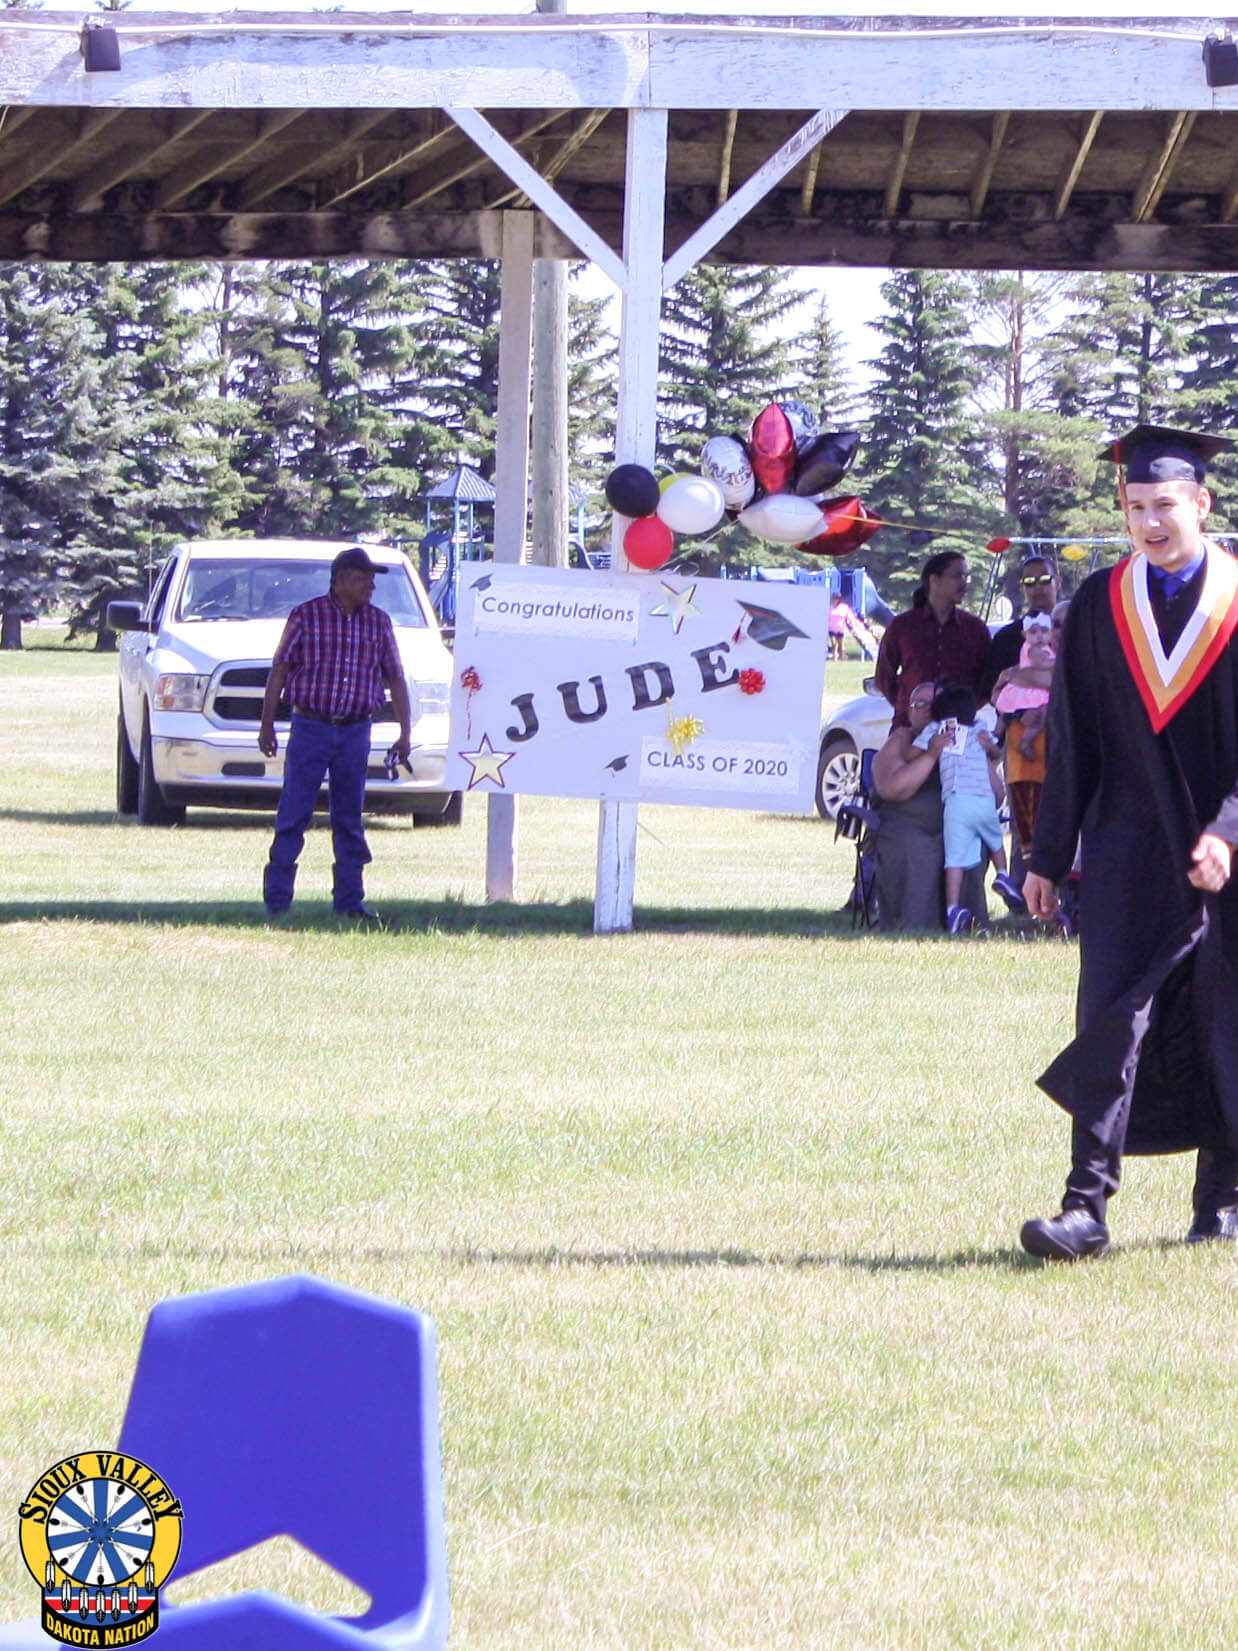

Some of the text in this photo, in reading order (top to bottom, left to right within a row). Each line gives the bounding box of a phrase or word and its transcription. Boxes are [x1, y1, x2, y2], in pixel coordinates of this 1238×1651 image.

[481, 597, 635, 622] Congratulations
[505, 641, 740, 743] JUDE
[647, 751, 788, 776] CLASS OF 2020
